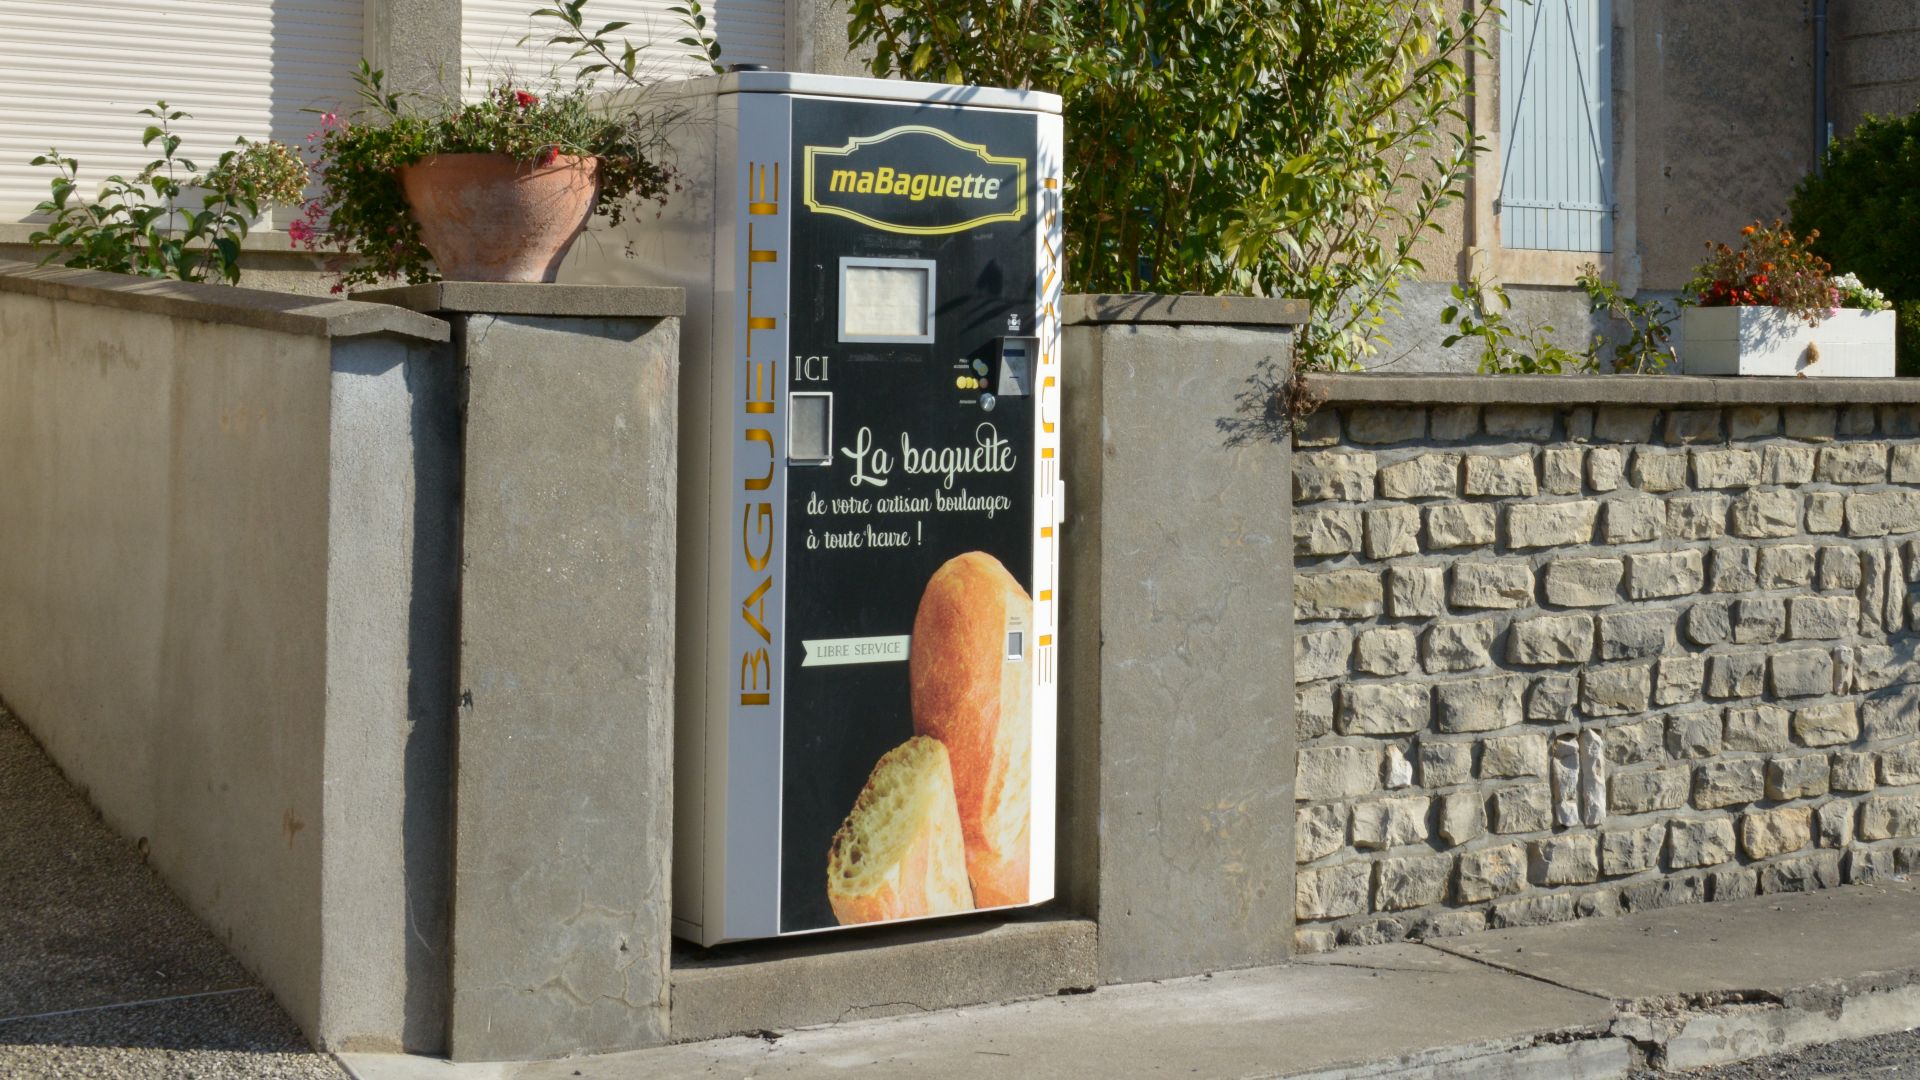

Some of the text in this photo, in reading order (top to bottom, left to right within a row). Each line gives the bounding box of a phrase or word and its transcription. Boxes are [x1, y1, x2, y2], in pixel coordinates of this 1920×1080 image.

[829, 167, 1001, 201] maBaguette
[794, 355, 829, 381] ICI
[741, 161, 779, 706] BAGUETTE
[1038, 177, 1057, 686] BAGUETTE
[840, 422, 1017, 489] La baguette
[806, 488, 1011, 519] de votre artisan boulanger
[806, 530, 820, 549] à
[824, 530, 862, 549] toute
[866, 524, 911, 549] heure
[816, 641, 901, 659] LIBRE SERVICE
